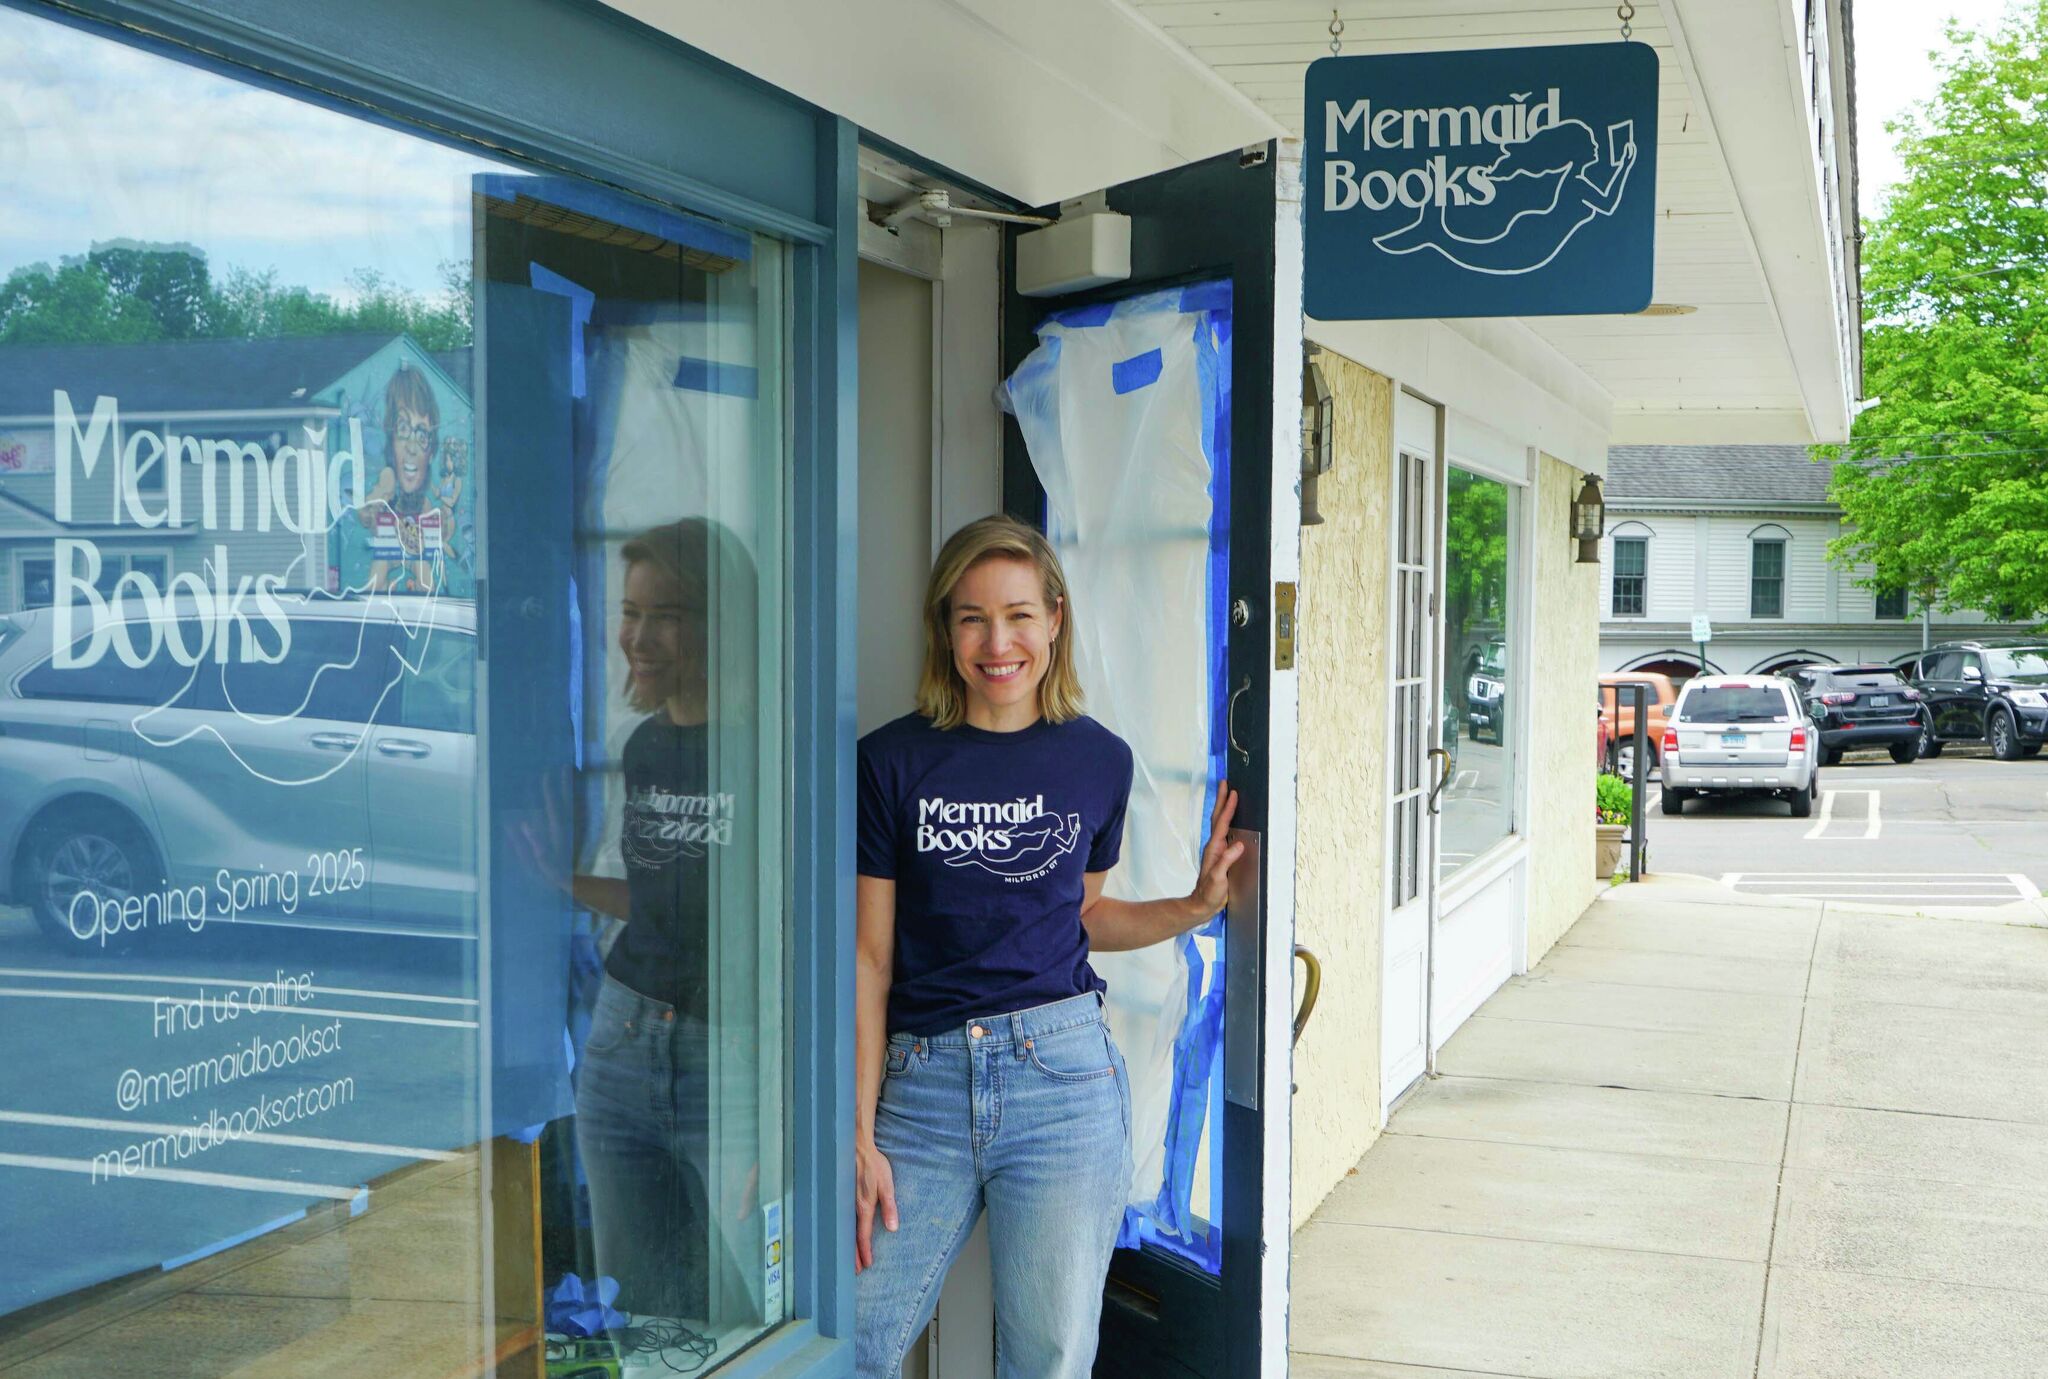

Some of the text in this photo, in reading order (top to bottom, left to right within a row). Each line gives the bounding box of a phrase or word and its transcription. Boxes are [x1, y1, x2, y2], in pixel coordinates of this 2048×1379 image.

[1324, 87, 1560, 153] Mermaid
[1323, 154, 1497, 212] Books
[53, 389, 366, 534] Mermaid
[52, 538, 292, 670] Books
[917, 824, 1012, 853] Books
[918, 794, 1044, 825] Mermaid
[69, 847, 366, 948] Opening Spring 2025
[1004, 858, 1058, 884] MILFORD, CT
[153, 969, 315, 1038] Find us online:
[116, 1018, 343, 1112] @mermaidbooksct
[91, 1075, 355, 1186] mermaidbooksct.com
